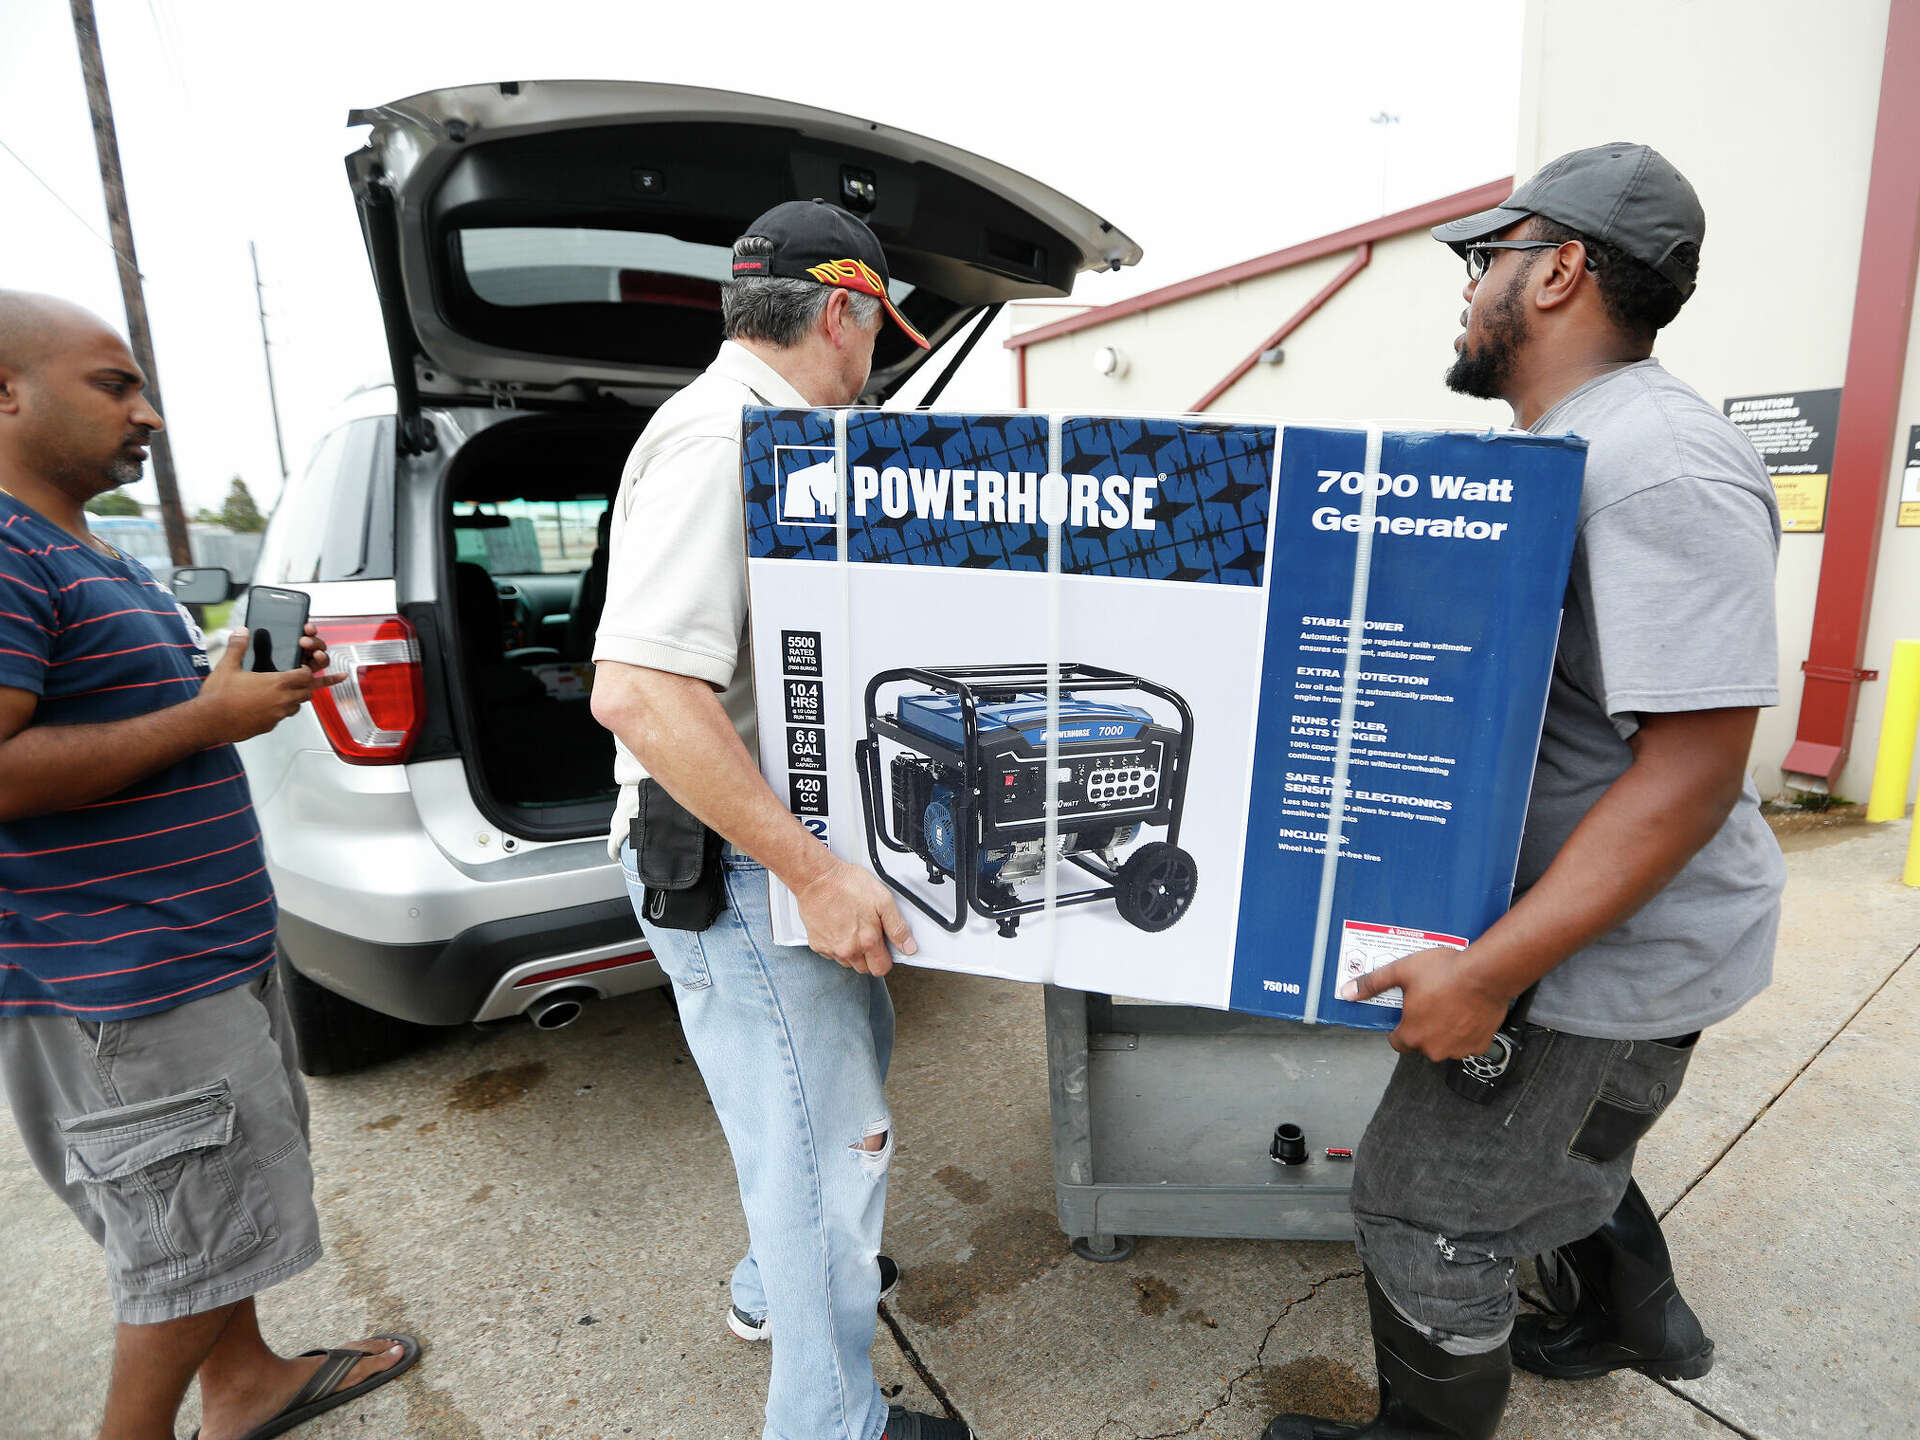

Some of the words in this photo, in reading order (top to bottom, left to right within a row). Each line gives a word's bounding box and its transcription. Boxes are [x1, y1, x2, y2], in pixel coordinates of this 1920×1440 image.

[1430, 474, 1514, 503] Watt
[1302, 616, 1351, 628] STABLE
[1357, 619, 1404, 632] OWER
[787, 636, 815, 648] 5500
[1300, 632, 1342, 643] Automatic
[1374, 638, 1412, 648] regulator
[1412, 641, 1431, 649] with
[1432, 643, 1473, 652] voltmeter
[789, 648, 815, 656] RATED
[1299, 644, 1331, 654] ensures
[1377, 650, 1409, 660] reliable
[1409, 653, 1436, 661] power
[787, 655, 817, 665] WATTS
[1296, 666, 1341, 679] EXTRA
[789, 683, 818, 697] 10.4
[1295, 681, 1312, 691] Low
[1313, 683, 1324, 691] oil
[1365, 687, 1420, 700] automatically
[1420, 693, 1455, 703] protects
[791, 696, 818, 709] HRS
[1294, 693, 1321, 703] engine
[1322, 695, 1342, 704] from
[1342, 698, 1375, 707] mage
[1098, 725, 1124, 736] 7000
[1291, 715, 1328, 727] RUNS
[1331, 718, 1388, 733] COLER,
[795, 730, 817, 744] 6.6
[1290, 725, 1331, 738] LASTS
[1333, 730, 1387, 743] LNGER
[792, 742, 822, 756] GAL
[1290, 741, 1310, 750] 100%
[1367, 749, 1406, 759] generator
[1407, 752, 1428, 761] head
[1428, 755, 1456, 765] allows
[1288, 751, 1331, 763] continuous
[1332, 755, 1370, 766] oation
[1370, 760, 1401, 770] without
[1401, 764, 1449, 776] overheating
[796, 778, 821, 792] 420
[1285, 772, 1320, 784] SAFE
[1322, 775, 1352, 788] FR
[800, 792, 818, 803] CC
[1284, 783, 1353, 798] SENSITE
[1355, 790, 1452, 811] ELECTRONICS
[1281, 808, 1315, 818] sensitive
[1283, 797, 1301, 807] Less
[1302, 799, 1320, 808] than
[1352, 805, 1377, 815] allows
[1378, 808, 1390, 816] for
[1390, 810, 1415, 820] safely
[1415, 814, 1447, 825] running
[1280, 828, 1350, 844] INCLUDS:
[1278, 842, 1302, 853] Wheel
[1303, 846, 1313, 854] kit
[1314, 847, 1331, 857] wit
[1363, 853, 1381, 862] tires
[1262, 980, 1300, 995] 750140
